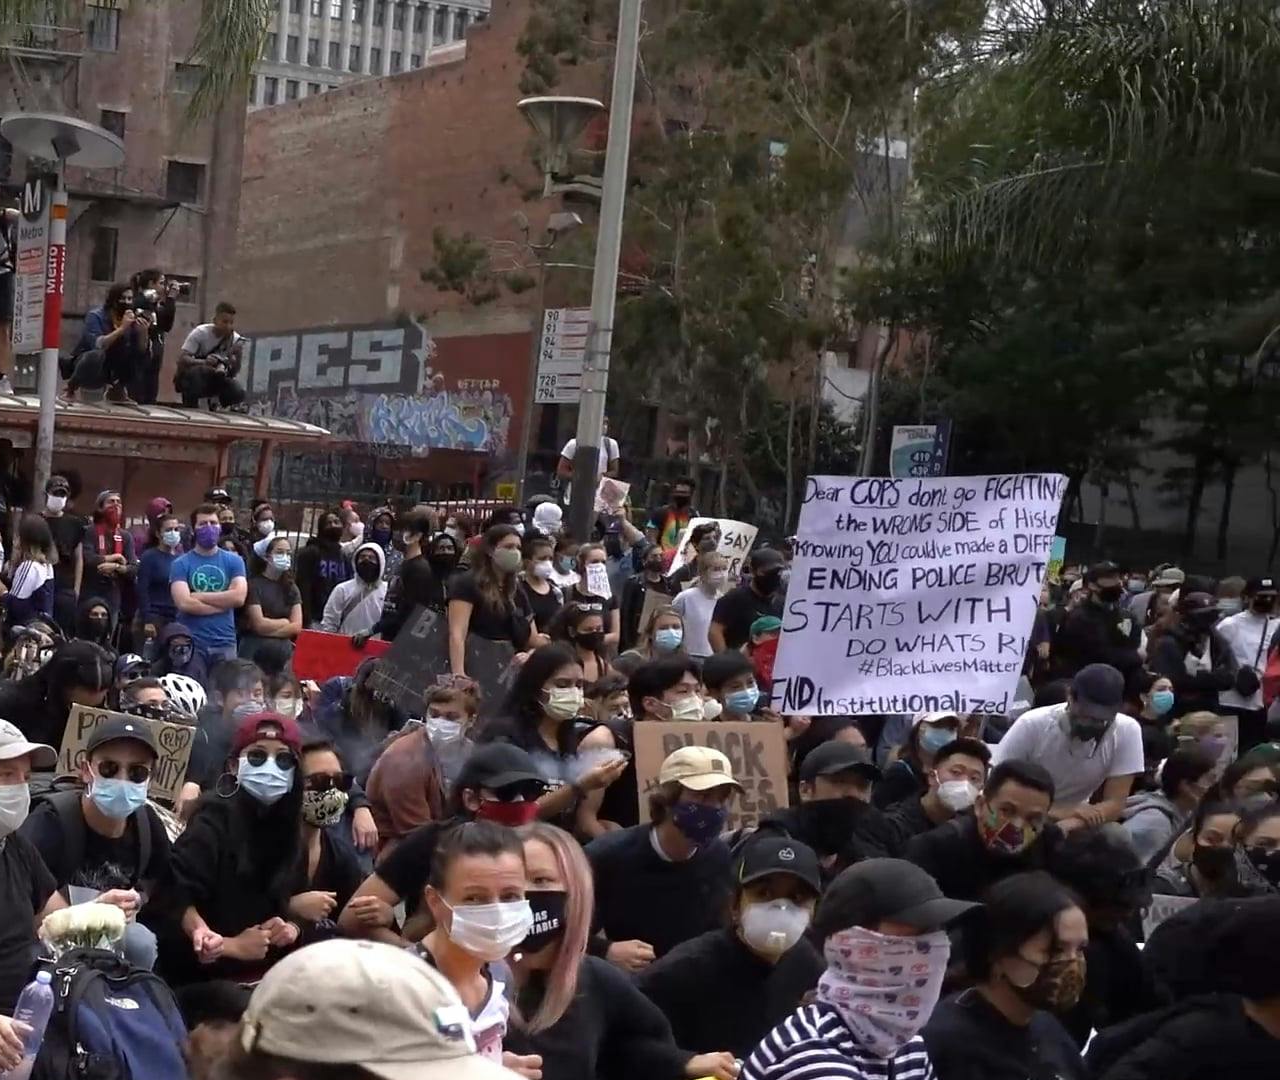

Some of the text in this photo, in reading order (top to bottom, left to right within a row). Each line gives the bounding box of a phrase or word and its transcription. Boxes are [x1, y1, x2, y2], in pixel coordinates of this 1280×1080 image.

[547, 311, 559, 321] 90
[546, 324, 556, 333] 91
[545, 337, 556, 346] 94
[241, 329, 406, 393] PES
[543, 350, 554, 359] 94
[538, 389, 555, 399] 794
[802, 478, 844, 504] Dear
[850, 479, 903, 506] COPS
[954, 487, 976, 507] go
[835, 512, 867, 532] the
[872, 512, 933, 535] WRONG
[937, 511, 981, 533] SIDE
[989, 508, 1008, 530] of
[724, 532, 752, 549] SAY
[791, 537, 864, 566] Knowing
[867, 539, 898, 563] YOU
[955, 536, 995, 555] made
[998, 540, 1008, 554] a
[1014, 534, 1055, 554] DIFF
[807, 567, 899, 592] ENDING
[912, 563, 977, 590] POLICE
[782, 597, 1011, 632] STARTS WITH
[846, 637, 886, 657] DO
[895, 634, 986, 653] WHATS
[857, 657, 1020, 678] #BlackLivesMatter
[817, 689, 1009, 715] Institutionalized
